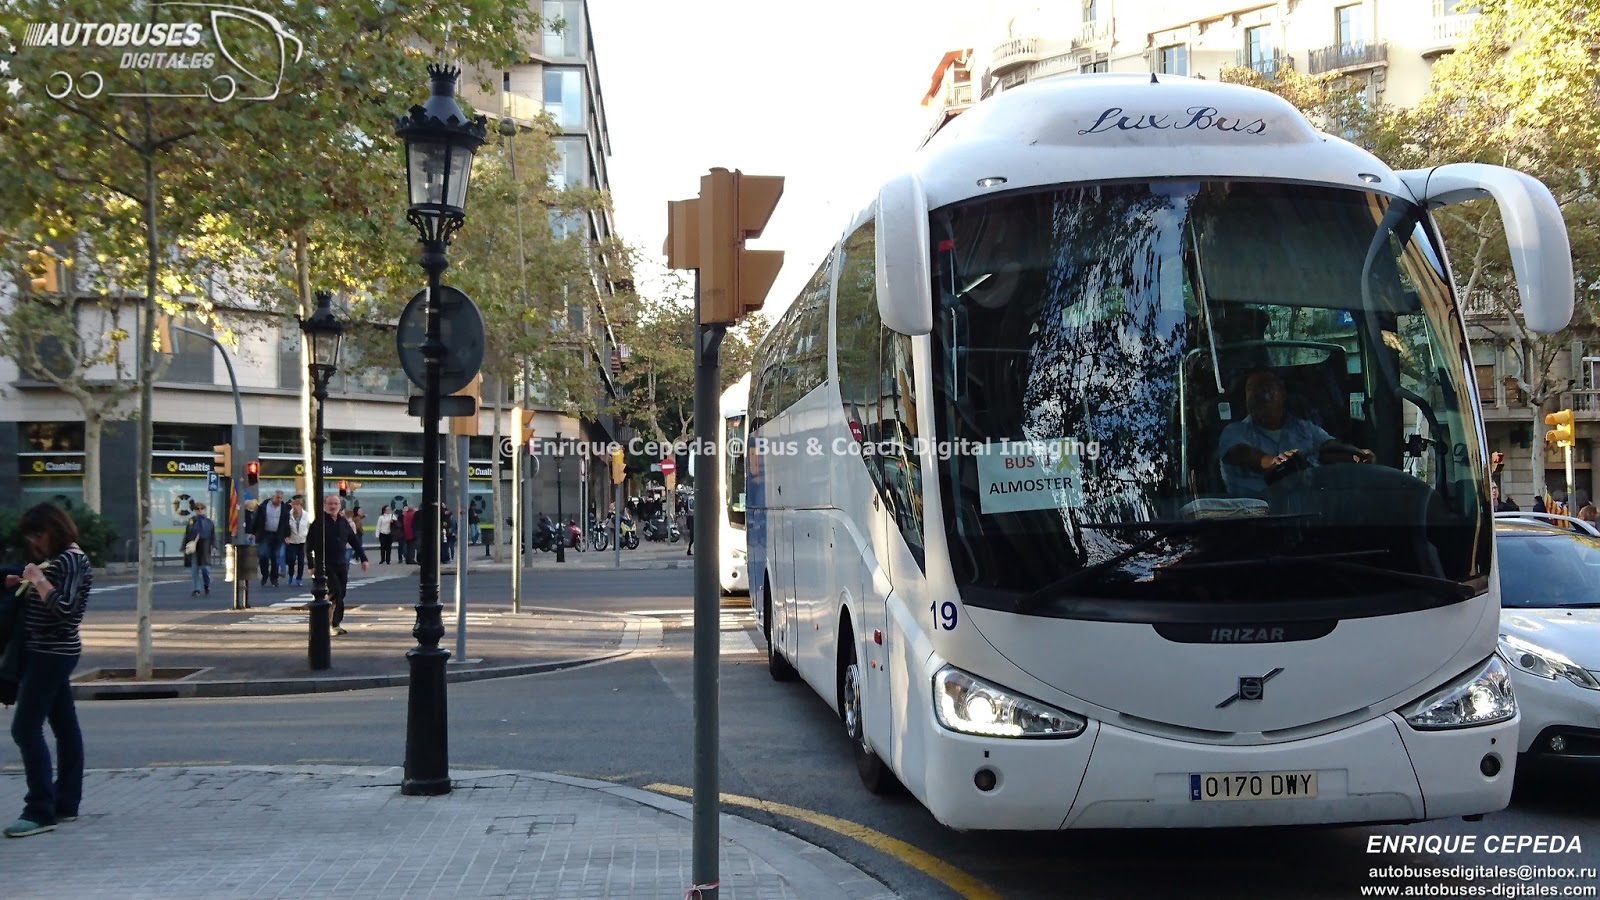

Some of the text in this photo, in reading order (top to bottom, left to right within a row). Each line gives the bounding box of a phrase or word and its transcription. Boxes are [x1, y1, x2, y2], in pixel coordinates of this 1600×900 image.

[1077, 106, 1267, 136] Lux Bus
[178, 462, 210, 472] Cualtis
[1005, 455, 1035, 470] BUS
[210, 474, 217, 483] P
[475, 468, 493, 476] Cualt
[989, 477, 1073, 495] ALMOSTER
[930, 600, 958, 631] 19
[1211, 627, 1285, 642] IRIZAR
[1206, 774, 1312, 797] 0170 DWY
